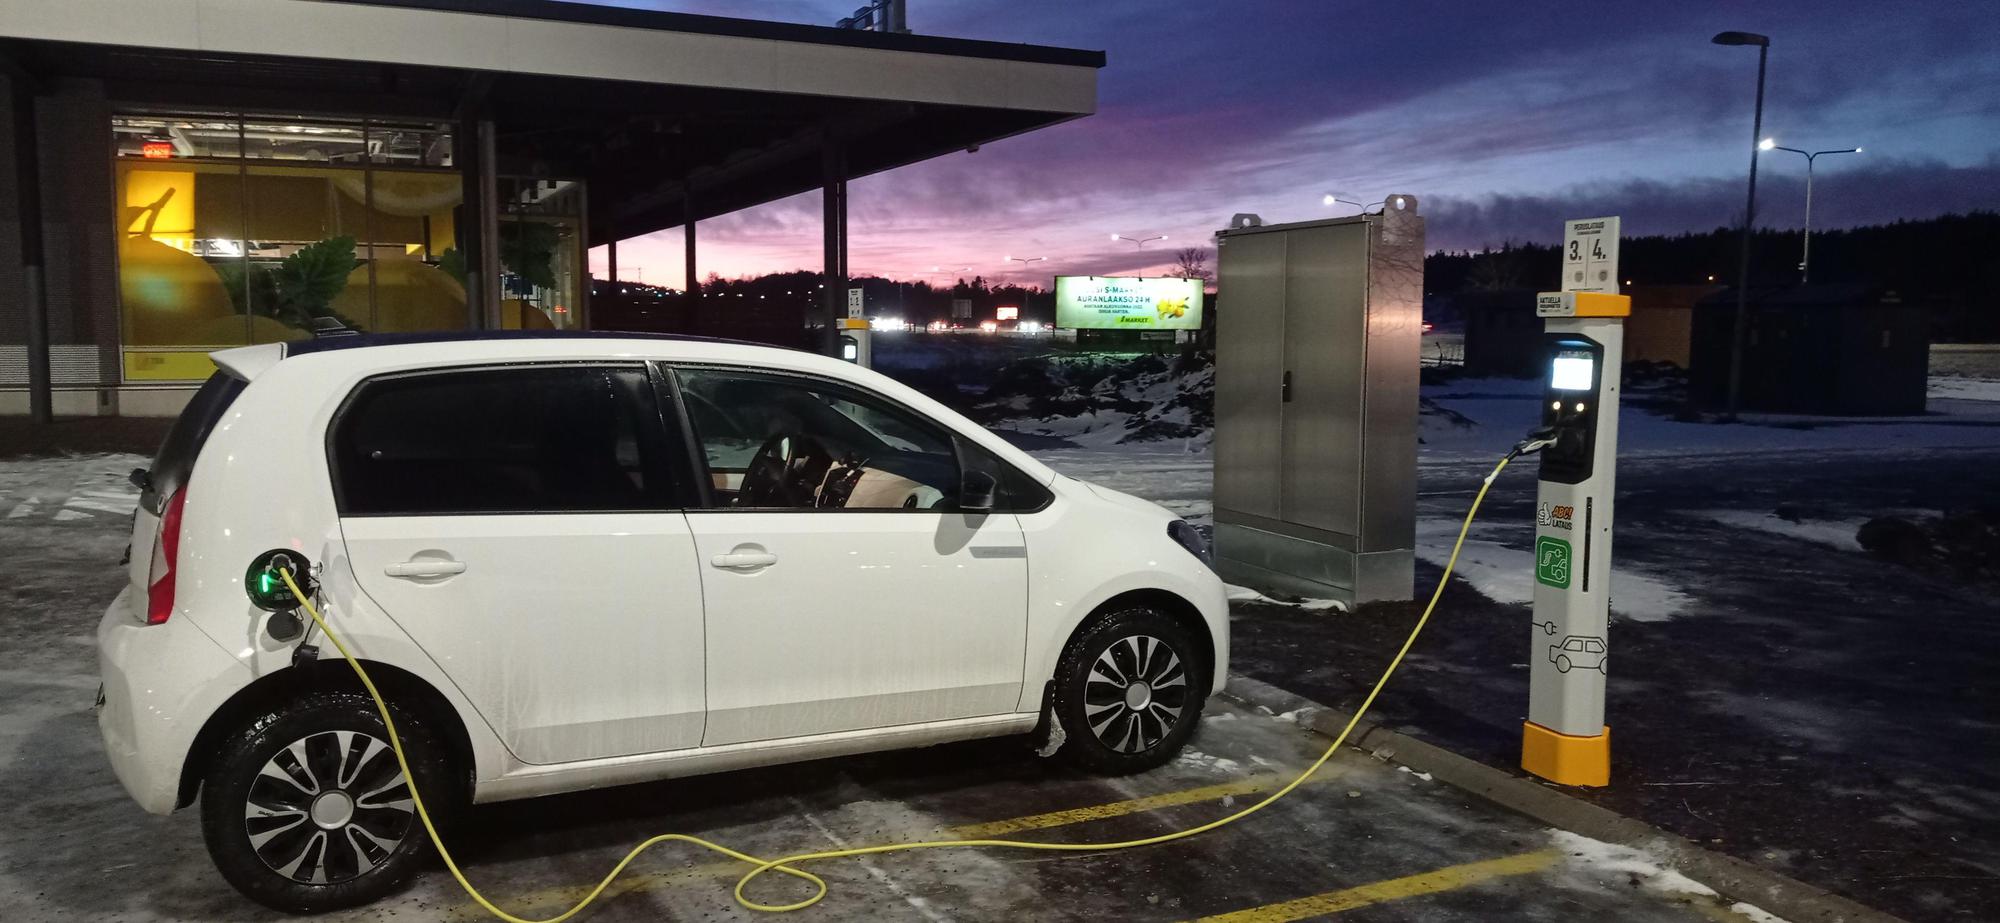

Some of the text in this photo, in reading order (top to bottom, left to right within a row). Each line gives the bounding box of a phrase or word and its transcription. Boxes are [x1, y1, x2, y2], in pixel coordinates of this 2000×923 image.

[1569, 239, 1606, 261] 3. 4.
[1552, 505, 1573, 520] ABC!
